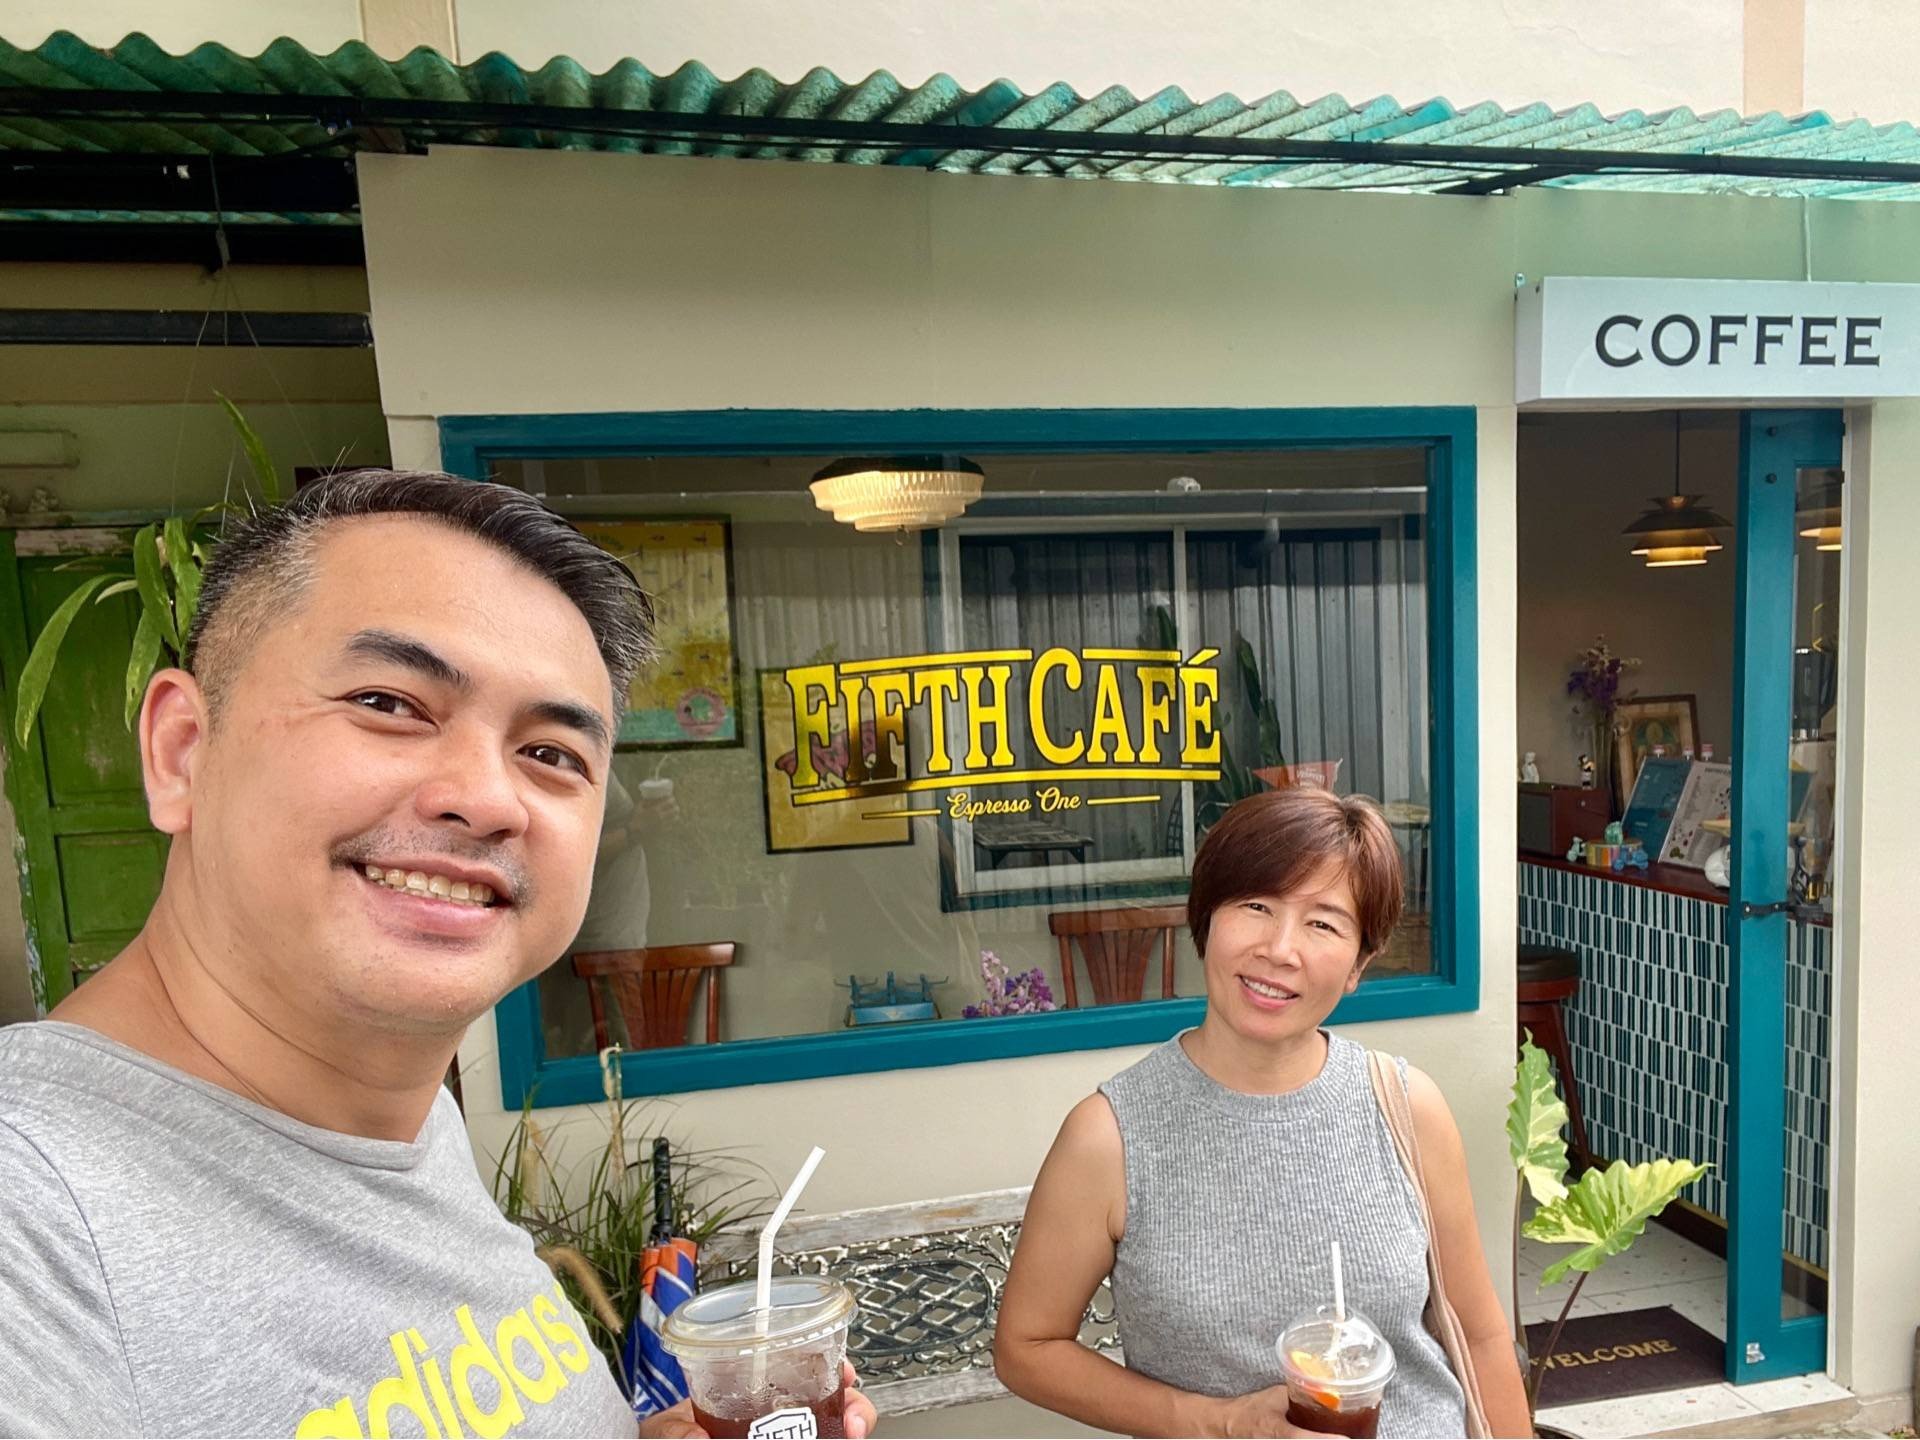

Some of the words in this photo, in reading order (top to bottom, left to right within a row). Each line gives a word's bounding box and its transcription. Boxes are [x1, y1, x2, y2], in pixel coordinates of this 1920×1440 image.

[1595, 314, 1882, 367] COFFEE
[785, 663, 1016, 788] FIFTH
[1029, 647, 1221, 765] CAFÉ
[947, 792, 1032, 822] Espresso
[1035, 786, 1081, 812] One
